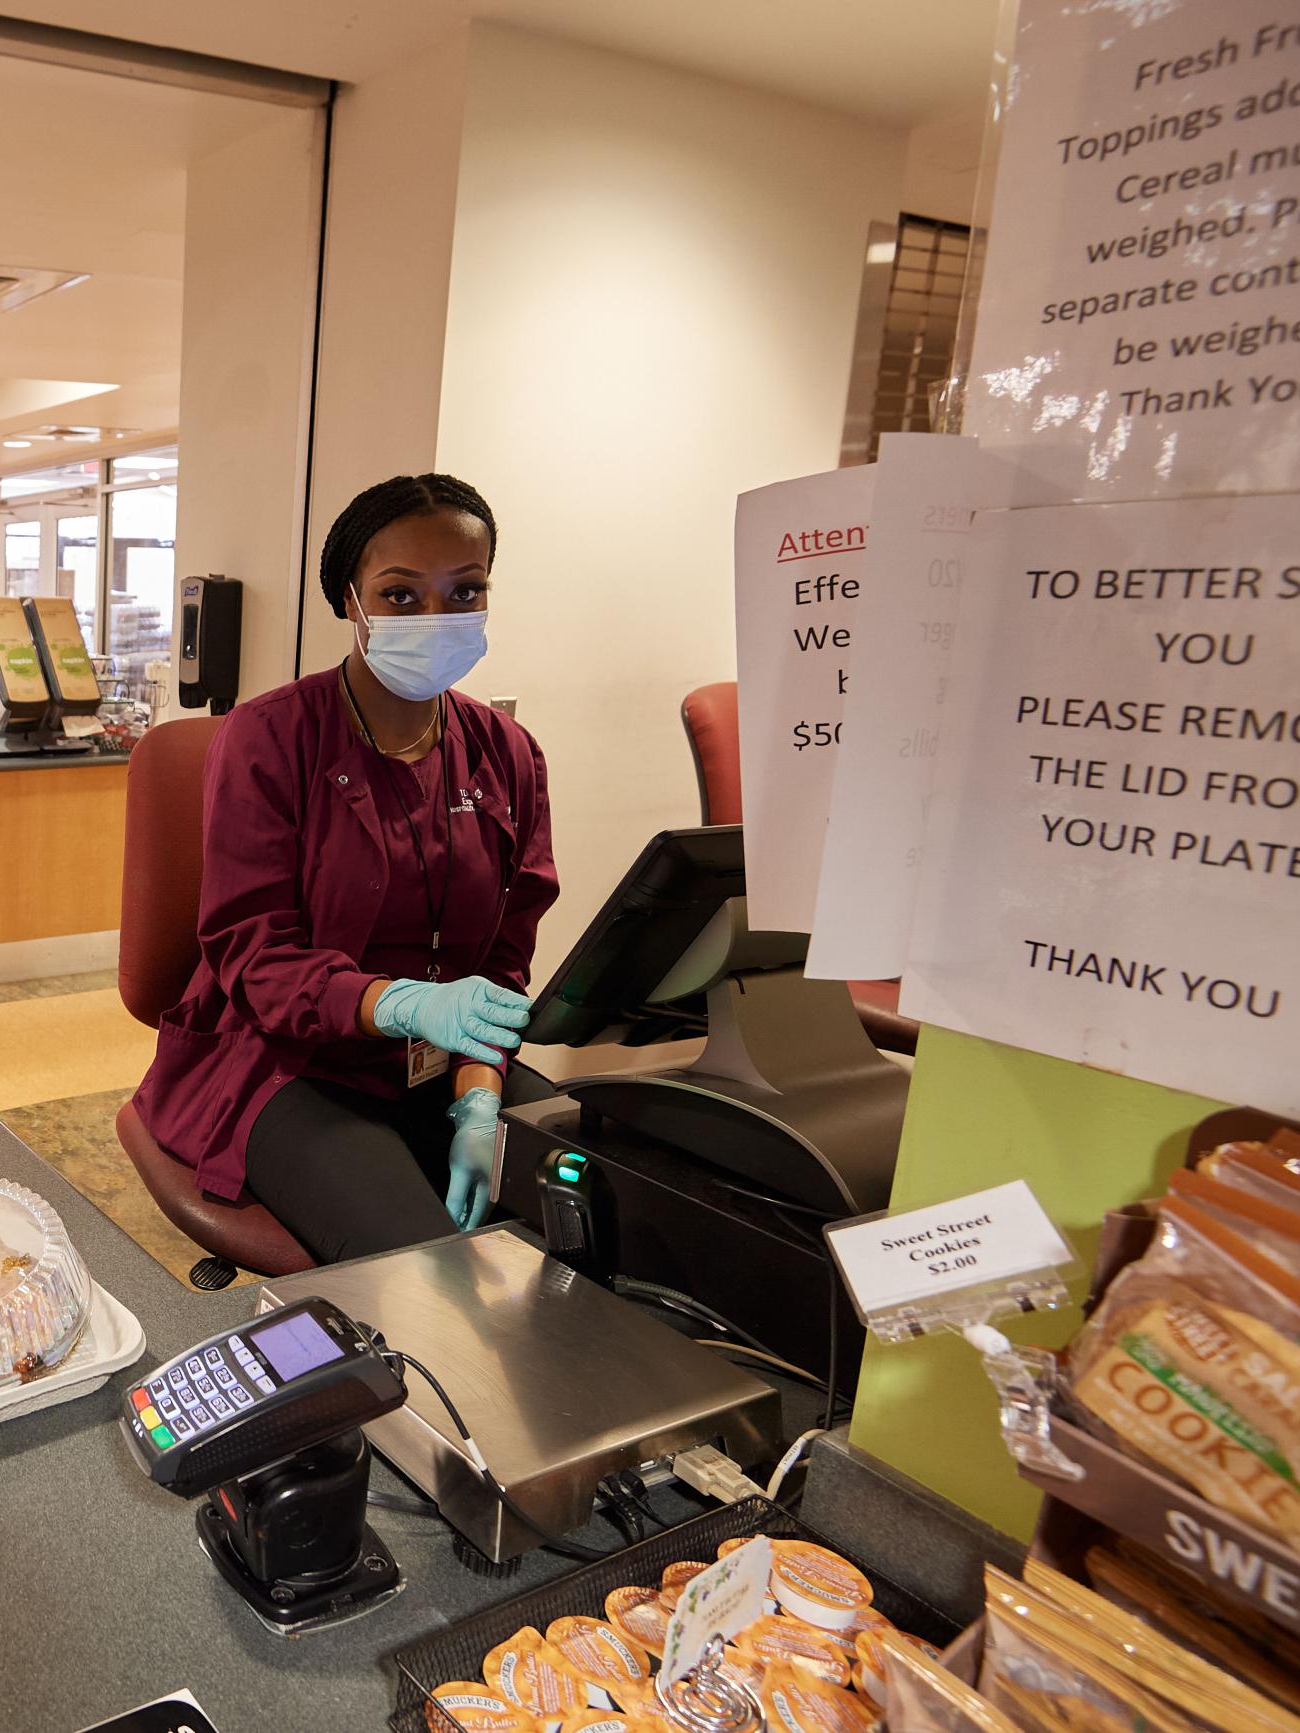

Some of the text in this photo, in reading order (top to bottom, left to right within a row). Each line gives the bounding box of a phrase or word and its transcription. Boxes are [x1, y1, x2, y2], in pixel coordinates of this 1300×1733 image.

[1135, 23, 1300, 91] Fresh Fr
[1058, 104, 1225, 164] Toppings
[1116, 149, 1239, 204] Cereal
[1087, 206, 1255, 263] weighed.
[1041, 256, 1300, 325] separate cont
[1113, 337, 1158, 366] be
[1121, 378, 1234, 417] Thank
[795, 574, 860, 605] Effe
[1026, 570, 1080, 599] TO
[1094, 567, 1262, 600] BETTER
[794, 625, 851, 651] We
[1156, 632, 1254, 666] YOU
[1017, 696, 1166, 733] PLEASE
[1030, 755, 1300, 809] THE LID FRO
[1042, 814, 1156, 856] YOUR
[1024, 940, 1280, 1018] THANK YOU
[881, 1214, 992, 1251] Sweet Street
[909, 1236, 981, 1262] Cookies
[927, 1254, 977, 1276] $2.00
[1163, 1508, 1300, 1618] SWE
